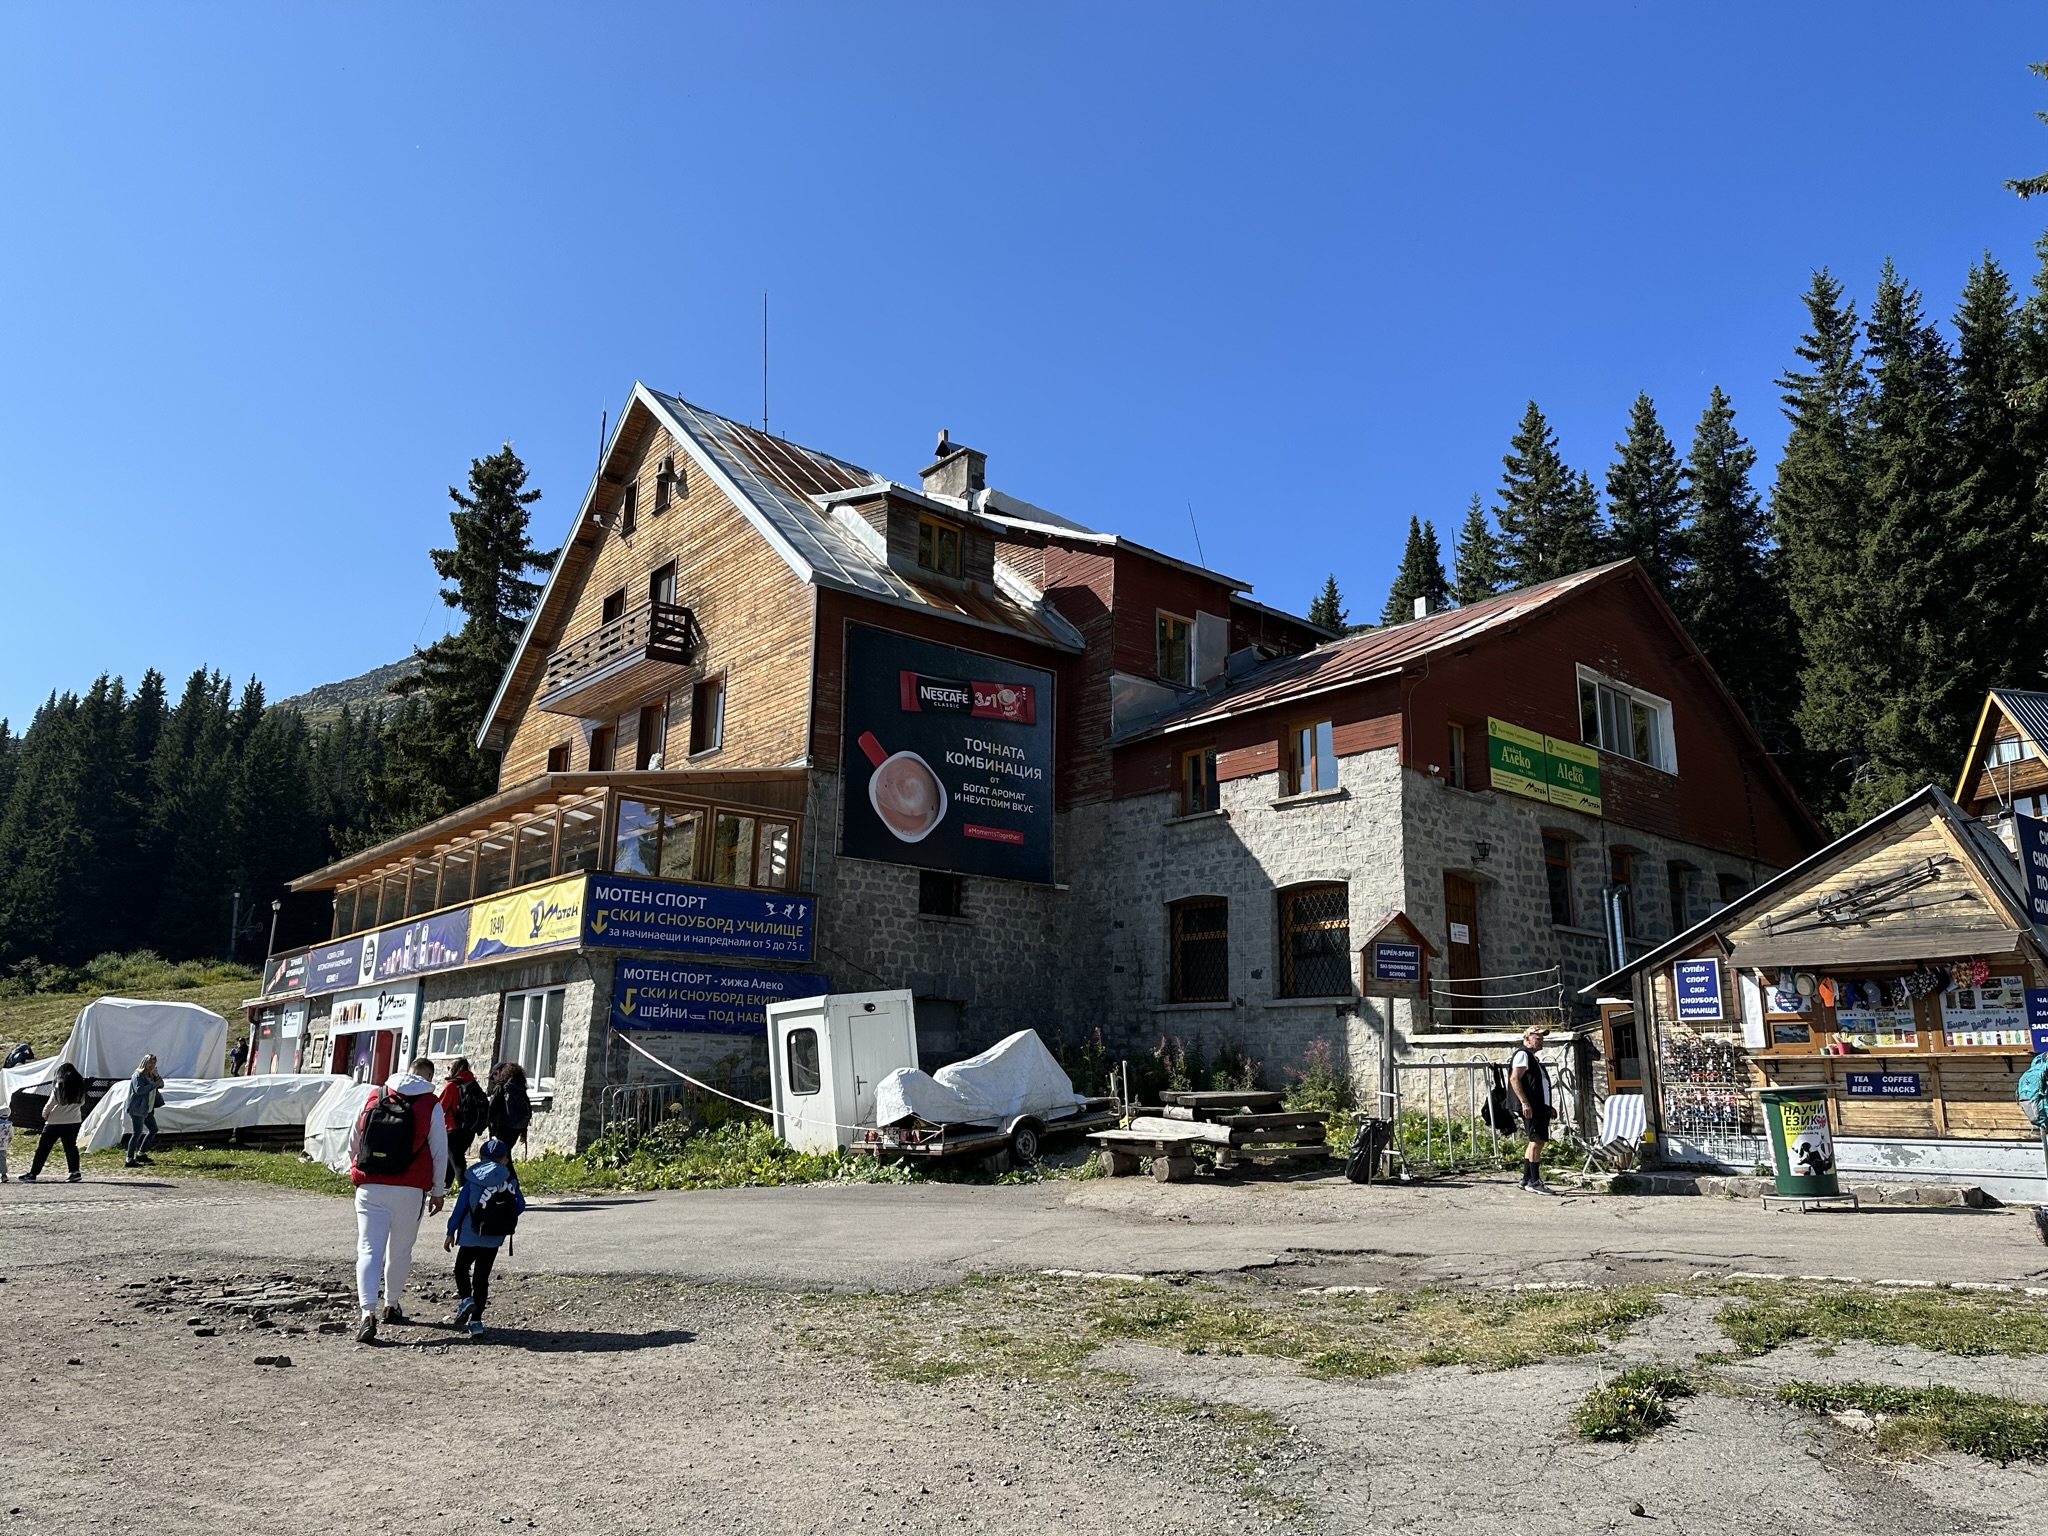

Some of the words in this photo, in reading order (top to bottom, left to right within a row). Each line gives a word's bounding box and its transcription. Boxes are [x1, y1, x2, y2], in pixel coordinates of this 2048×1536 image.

[920, 685, 969, 704] NESCAFÉ
[964, 737, 1025, 760] ТОЧНАТА
[946, 751, 1042, 780] КОМБИНАЦИЯ
[1557, 762, 1584, 784] Aleko
[990, 776, 1000, 784] от
[963, 783, 990, 795] БОГАТ
[992, 788, 1026, 801] АРОМАТ
[954, 793, 961, 801] И
[963, 794, 1011, 809] НЕУСТОИМ
[1012, 802, 1034, 814] ВКУС
[968, 826, 1020, 840] #MomentsTogether
[595, 886, 653, 904] МОТЕН
[656, 892, 708, 910] СПОРТ
[490, 915, 505, 935] 1840
[610, 908, 641, 922] СКИ
[644, 911, 655, 924] И
[658, 912, 734, 934] СНОУБОРД
[736, 920, 804, 939] УЧИЛИЩЕ
[608, 928, 620, 936] за
[622, 929, 680, 942] начинаещи
[684, 934, 690, 942] и
[692, 935, 751, 947] напреднали
[752, 940, 763, 948] от
[766, 940, 771, 949] 5
[772, 942, 785, 952] до
[786, 941, 797, 951] 75
[623, 968, 670, 982] МОТЕН
[671, 972, 712, 985] СПОРТ
[720, 978, 749, 988] хижа
[750, 978, 784, 990] Алеко
[640, 986, 666, 1000] СКИ
[668, 989, 678, 1000] И
[680, 990, 744, 1007] СНОУБОРД
[1690, 986, 1707, 994] СКИ-
[1680, 996, 1719, 1004] СНОУБОРД
[640, 1004, 688, 1019] ШЕЙНИ
[708, 1010, 734, 1024] ПОД
[738, 1012, 767, 1024] НАЕМ
[1995, 1016, 2020, 1028] Кафе
[1946, 1020, 1969, 1030] Бира
[1970, 1017, 1992, 1031] Вода
[1784, 1104, 1824, 1116] НАУЧИ
[1786, 1115, 1818, 1126] ЕЗИК
